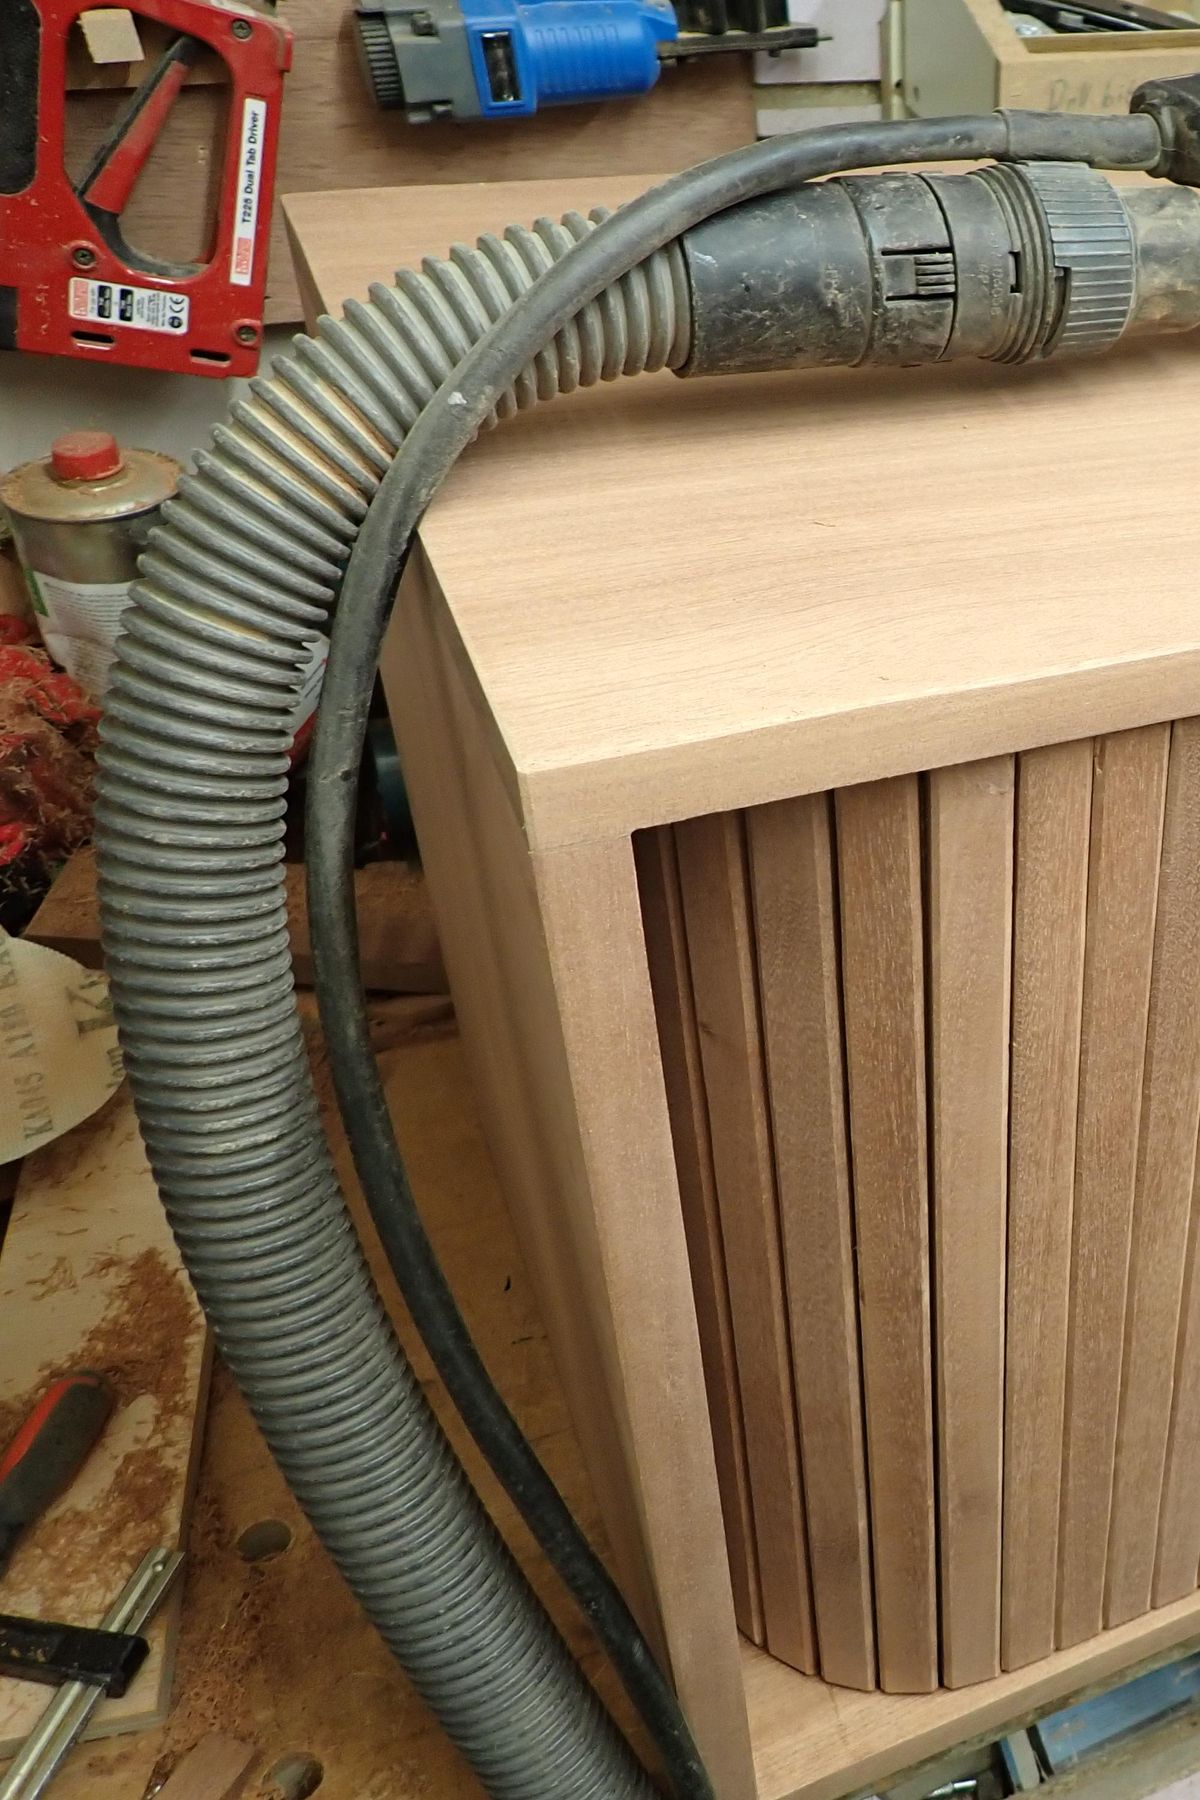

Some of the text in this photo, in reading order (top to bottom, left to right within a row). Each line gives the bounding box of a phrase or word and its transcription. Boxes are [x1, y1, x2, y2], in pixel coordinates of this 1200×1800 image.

[248, 111, 260, 144] Driver
[246, 148, 257, 166] Tab
[243, 170, 255, 195] Dual
